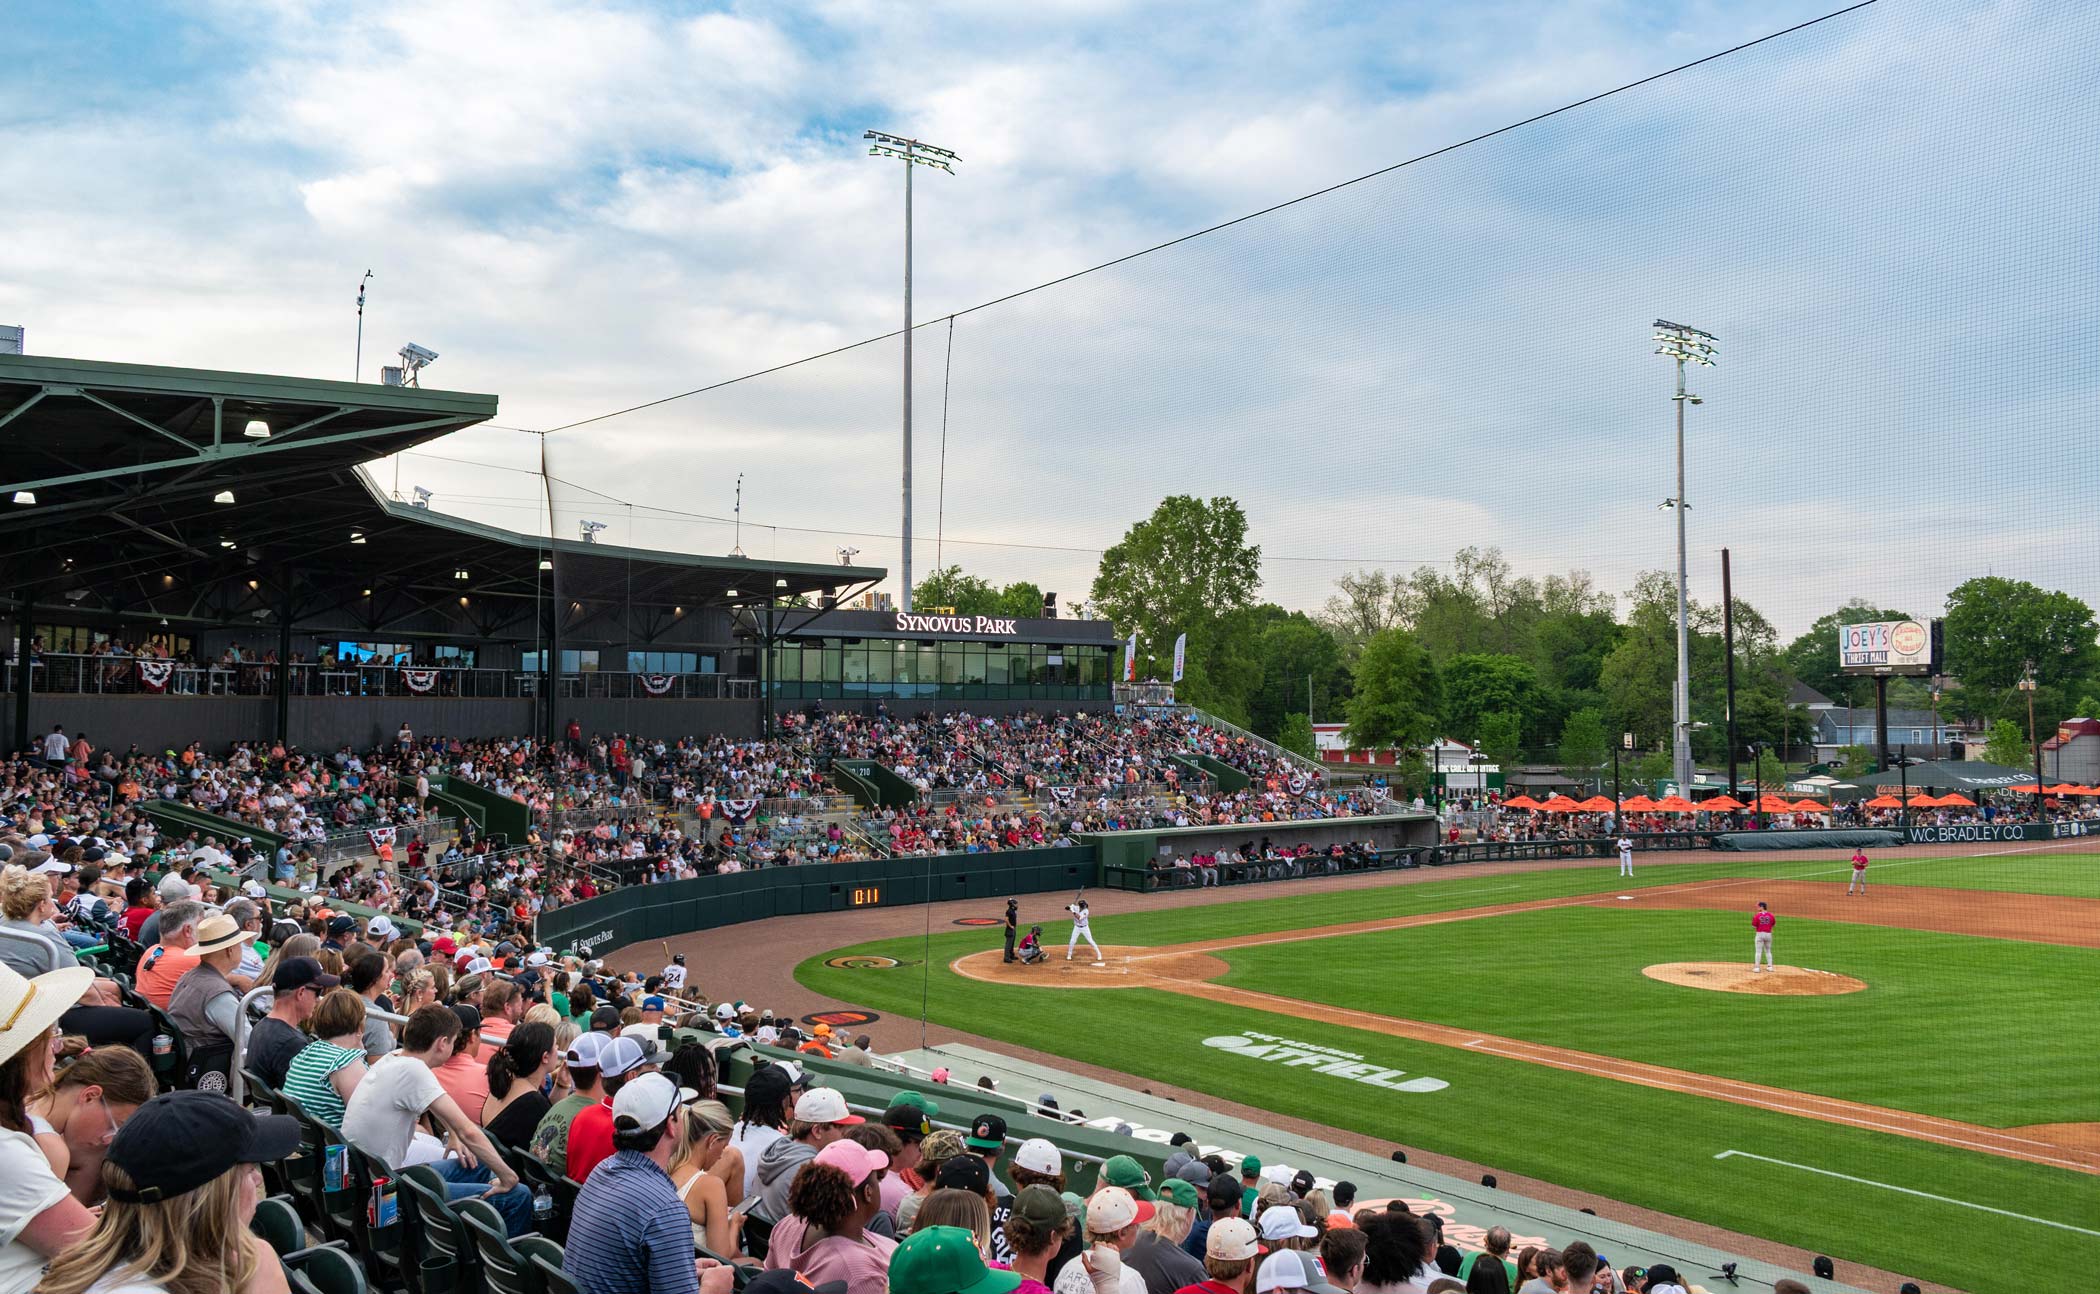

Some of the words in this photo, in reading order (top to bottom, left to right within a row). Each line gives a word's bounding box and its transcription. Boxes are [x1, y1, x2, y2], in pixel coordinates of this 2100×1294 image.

[896, 612, 971, 632] SYNOVUS
[975, 615, 1017, 635] PARK
[1843, 627, 1888, 650] JOEY'S
[1846, 653, 1869, 664] THRIFT
[1870, 651, 1887, 663] MALL
[859, 767, 871, 777] 210
[1792, 783, 1814, 794] YARD
[1938, 825, 2000, 842] BRADLEY
[2003, 825, 2024, 840] CO.
[668, 973, 681, 983] 24
